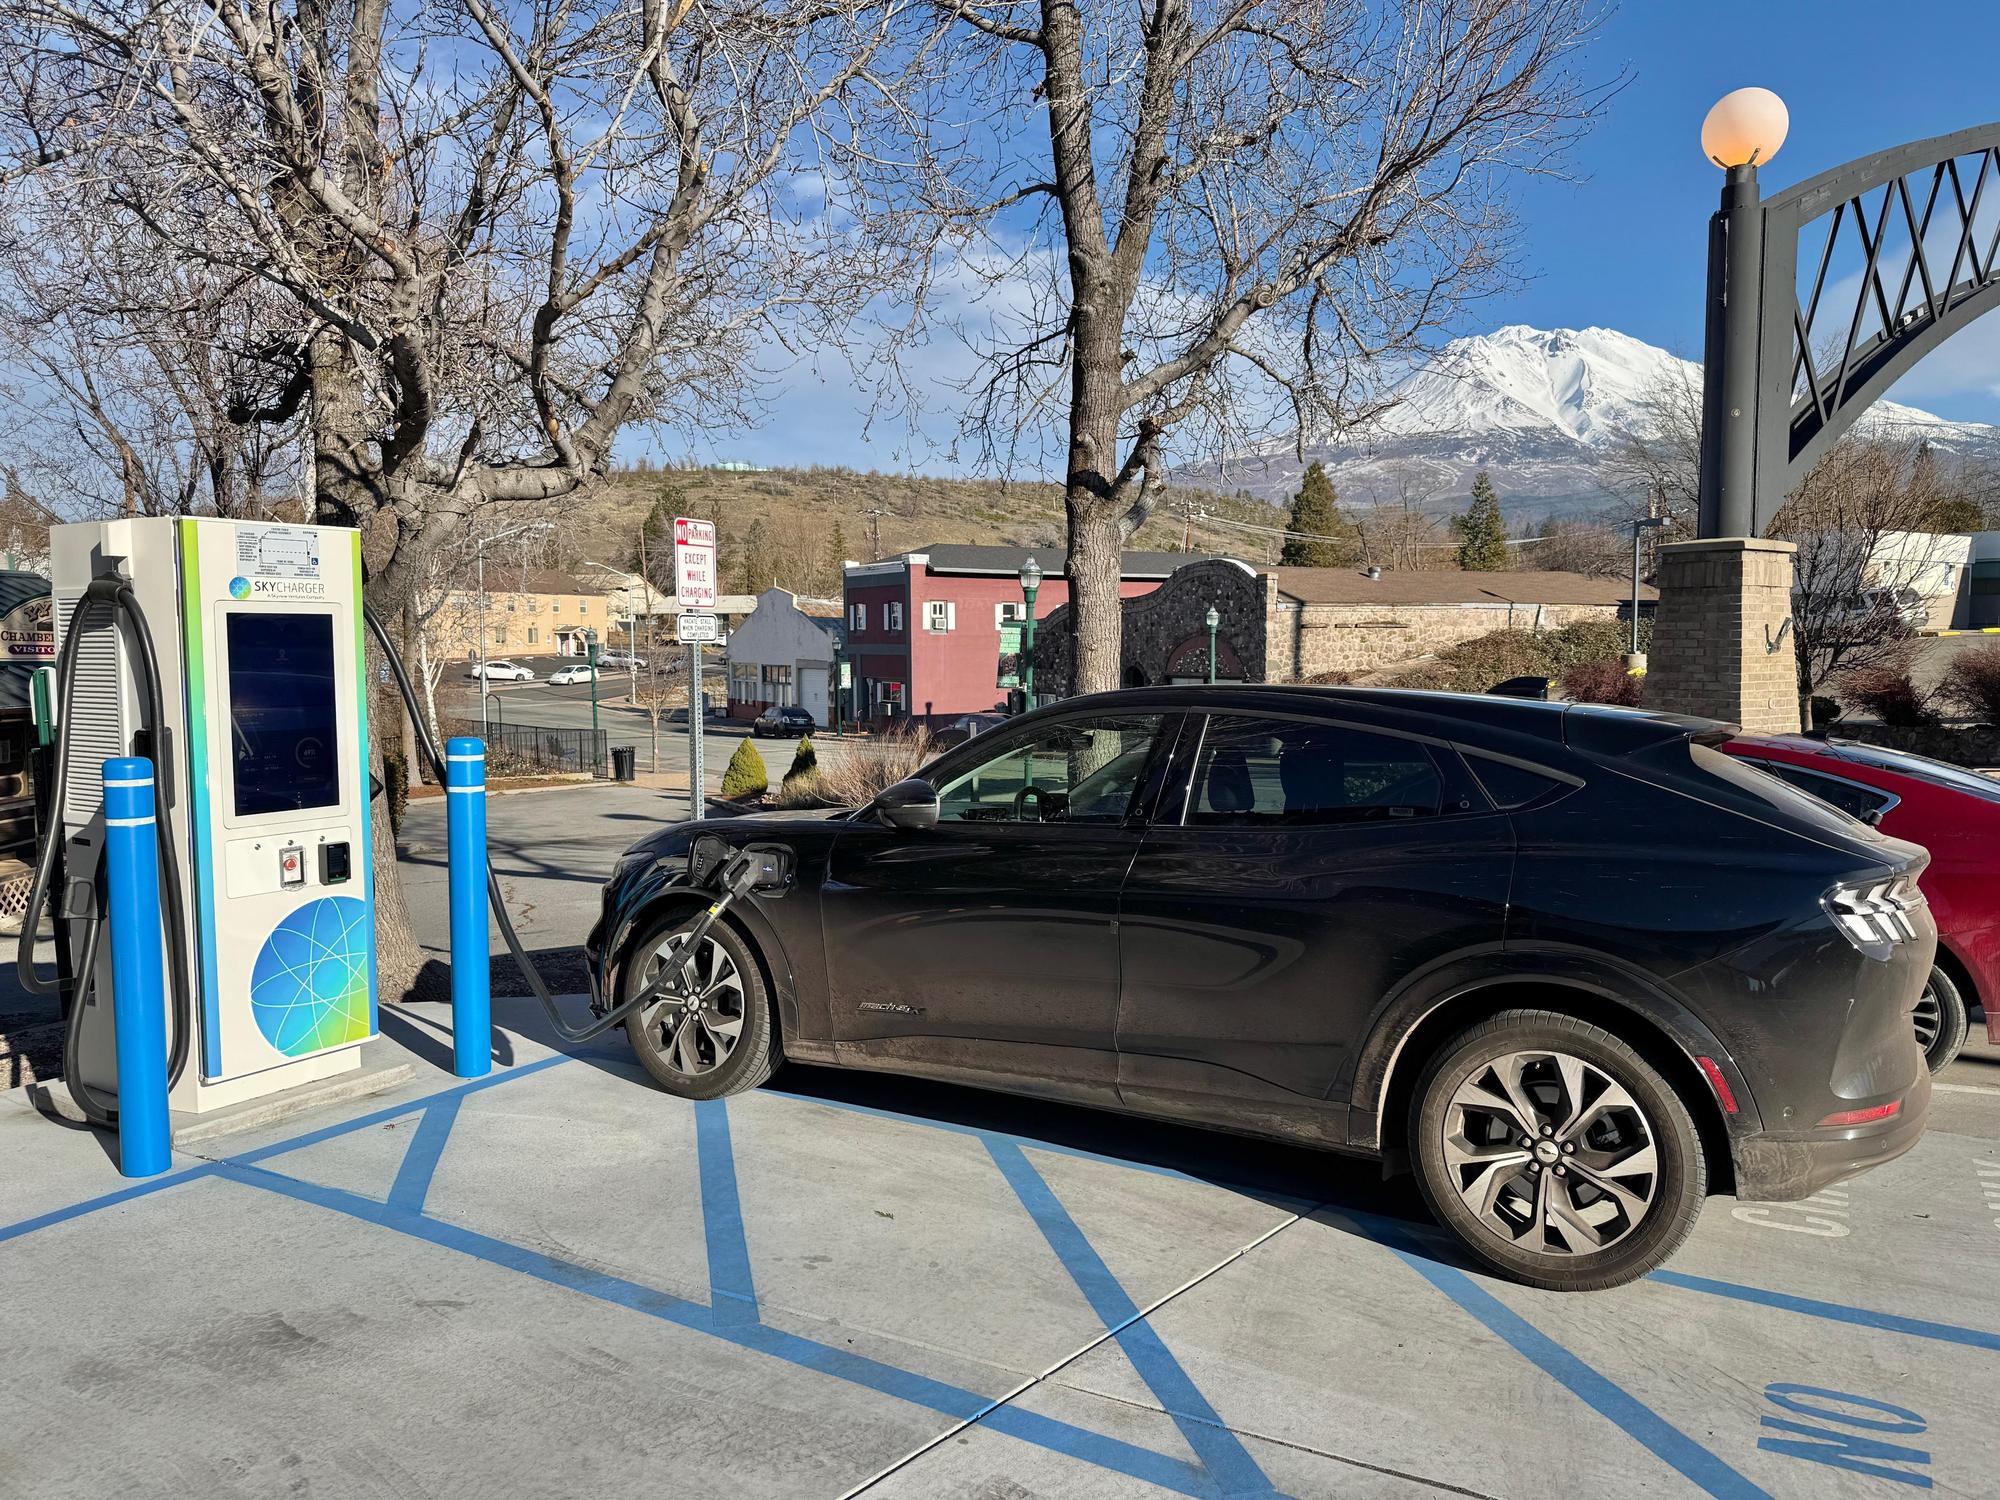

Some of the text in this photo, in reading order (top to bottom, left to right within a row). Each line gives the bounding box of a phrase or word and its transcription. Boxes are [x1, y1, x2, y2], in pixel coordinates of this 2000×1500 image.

[677, 524, 712, 541] NO PARKING
[684, 553, 707, 565] EXCEPT
[687, 570, 706, 582] WHILE
[254, 581, 325, 594] SKYCHARGER
[681, 587, 713, 599] CHARGING
[1756, 1382, 1934, 1489] NO
